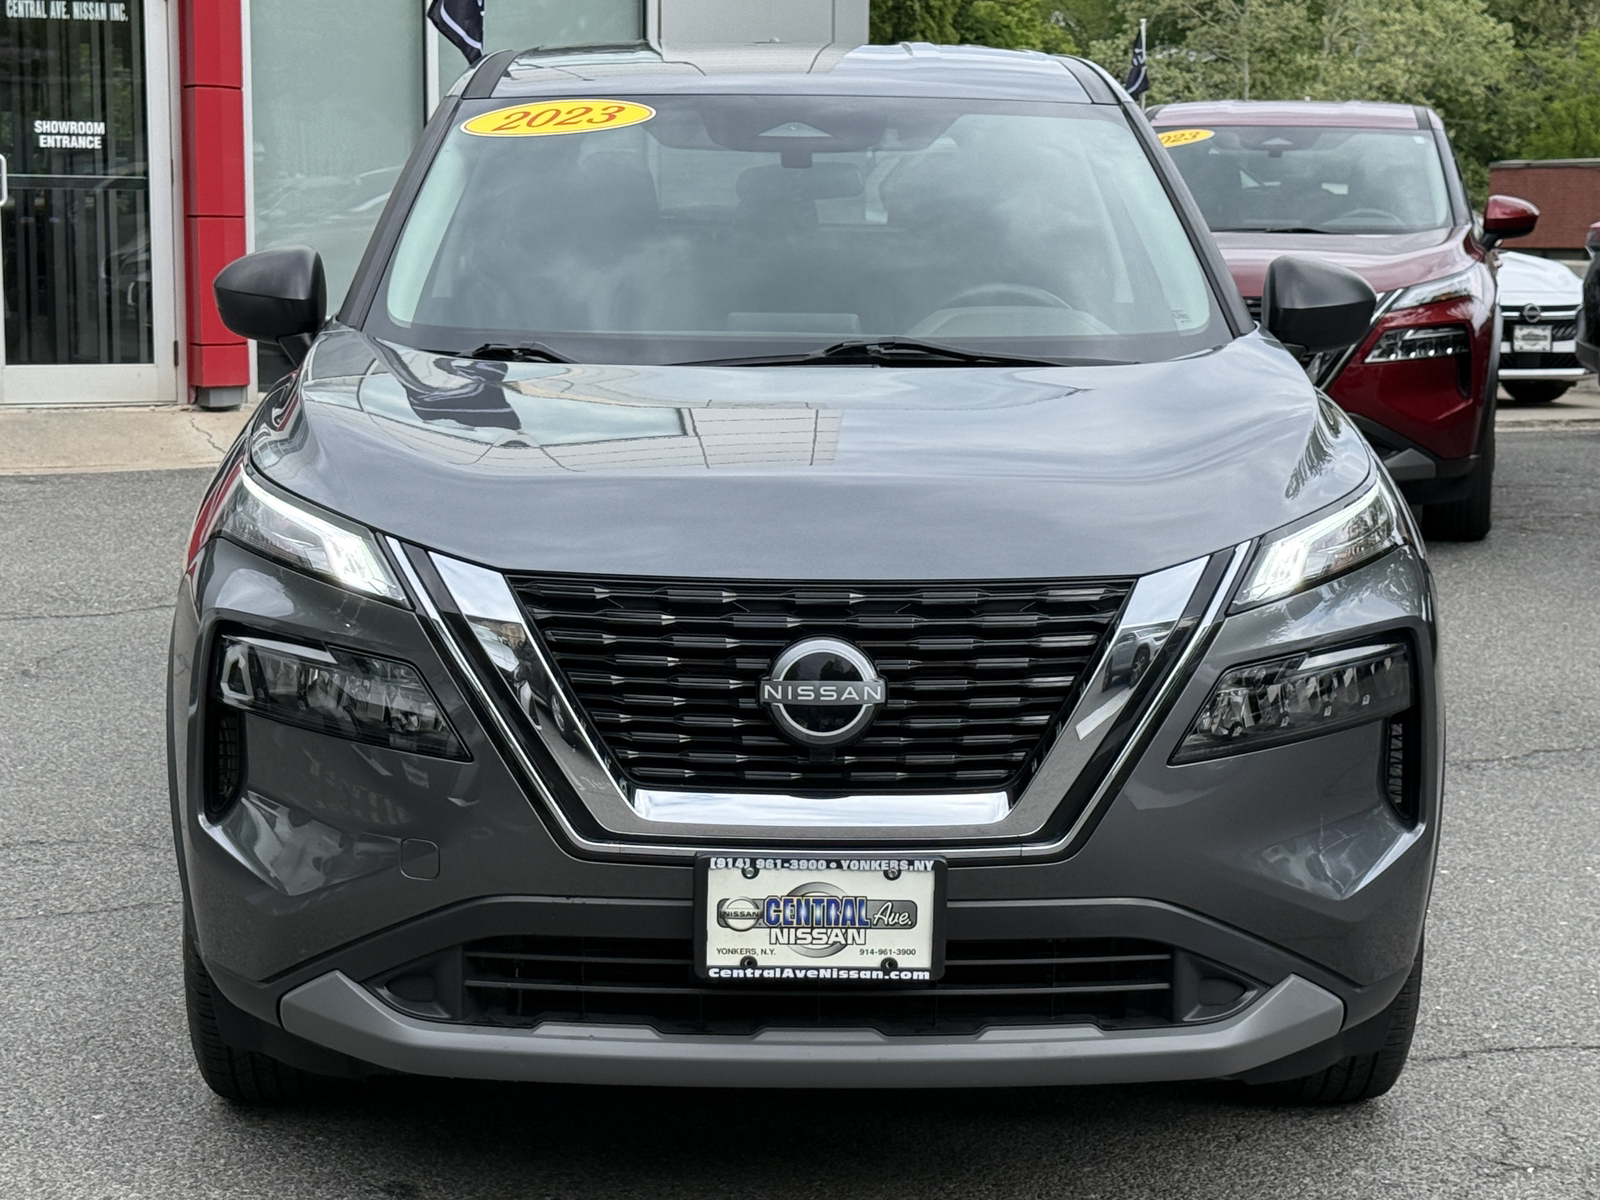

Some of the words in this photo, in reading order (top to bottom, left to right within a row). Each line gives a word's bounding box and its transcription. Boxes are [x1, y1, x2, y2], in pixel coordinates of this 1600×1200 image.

[6, 0, 47, 18] CENTRAL
[50, 1, 70, 19] AVE.
[72, 1, 107, 20] NISSAN
[492, 105, 626, 132] 2023
[33, 120, 106, 135] SHOWROOM
[39, 135, 102, 149] ENTRANCE
[1161, 131, 1200, 144] 023
[764, 684, 881, 701] NISSAN
[756, 859, 827, 870] 961-3900
[723, 910, 760, 918] NISSAN
[763, 895, 871, 928] CENTRAL
[872, 901, 912, 926] Ave.
[769, 928, 866, 945] NISSAN
[716, 947, 759, 956] YONKERS,
[760, 948, 776, 956] N.Y.
[859, 948, 916, 956] 914-961-3900
[708, 967, 930, 980] CentralAveNissan.com
